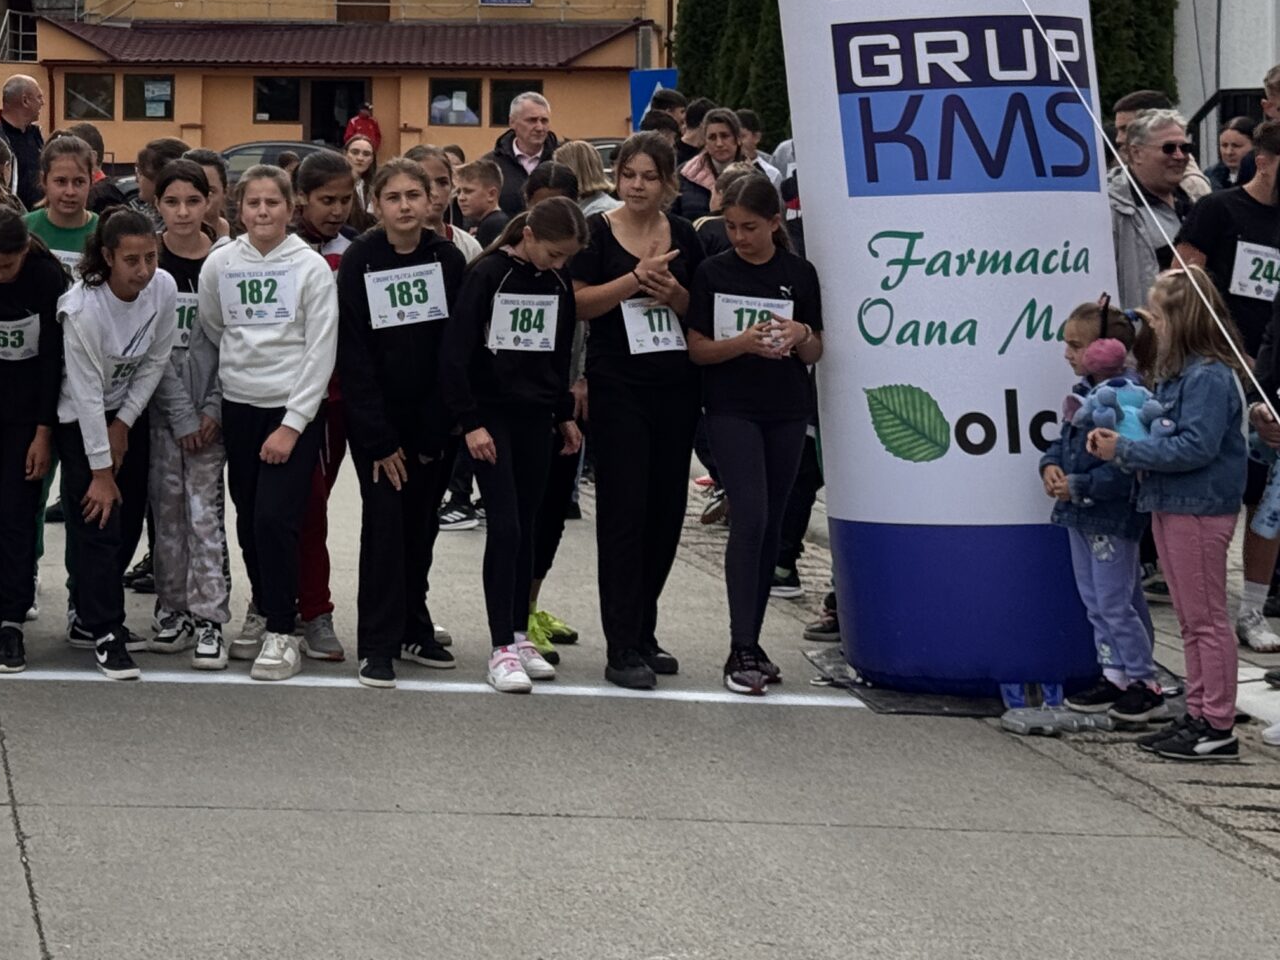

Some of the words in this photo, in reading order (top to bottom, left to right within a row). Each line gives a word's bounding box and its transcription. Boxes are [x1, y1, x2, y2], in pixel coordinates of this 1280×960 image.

[848, 28, 1081, 87] GRUP
[858, 91, 1090, 183] KMS
[867, 230, 1090, 291] Farmacia
[236, 278, 278, 305] 182
[384, 278, 429, 309] 183
[509, 307, 545, 334] 184
[857, 297, 978, 346] Oana
